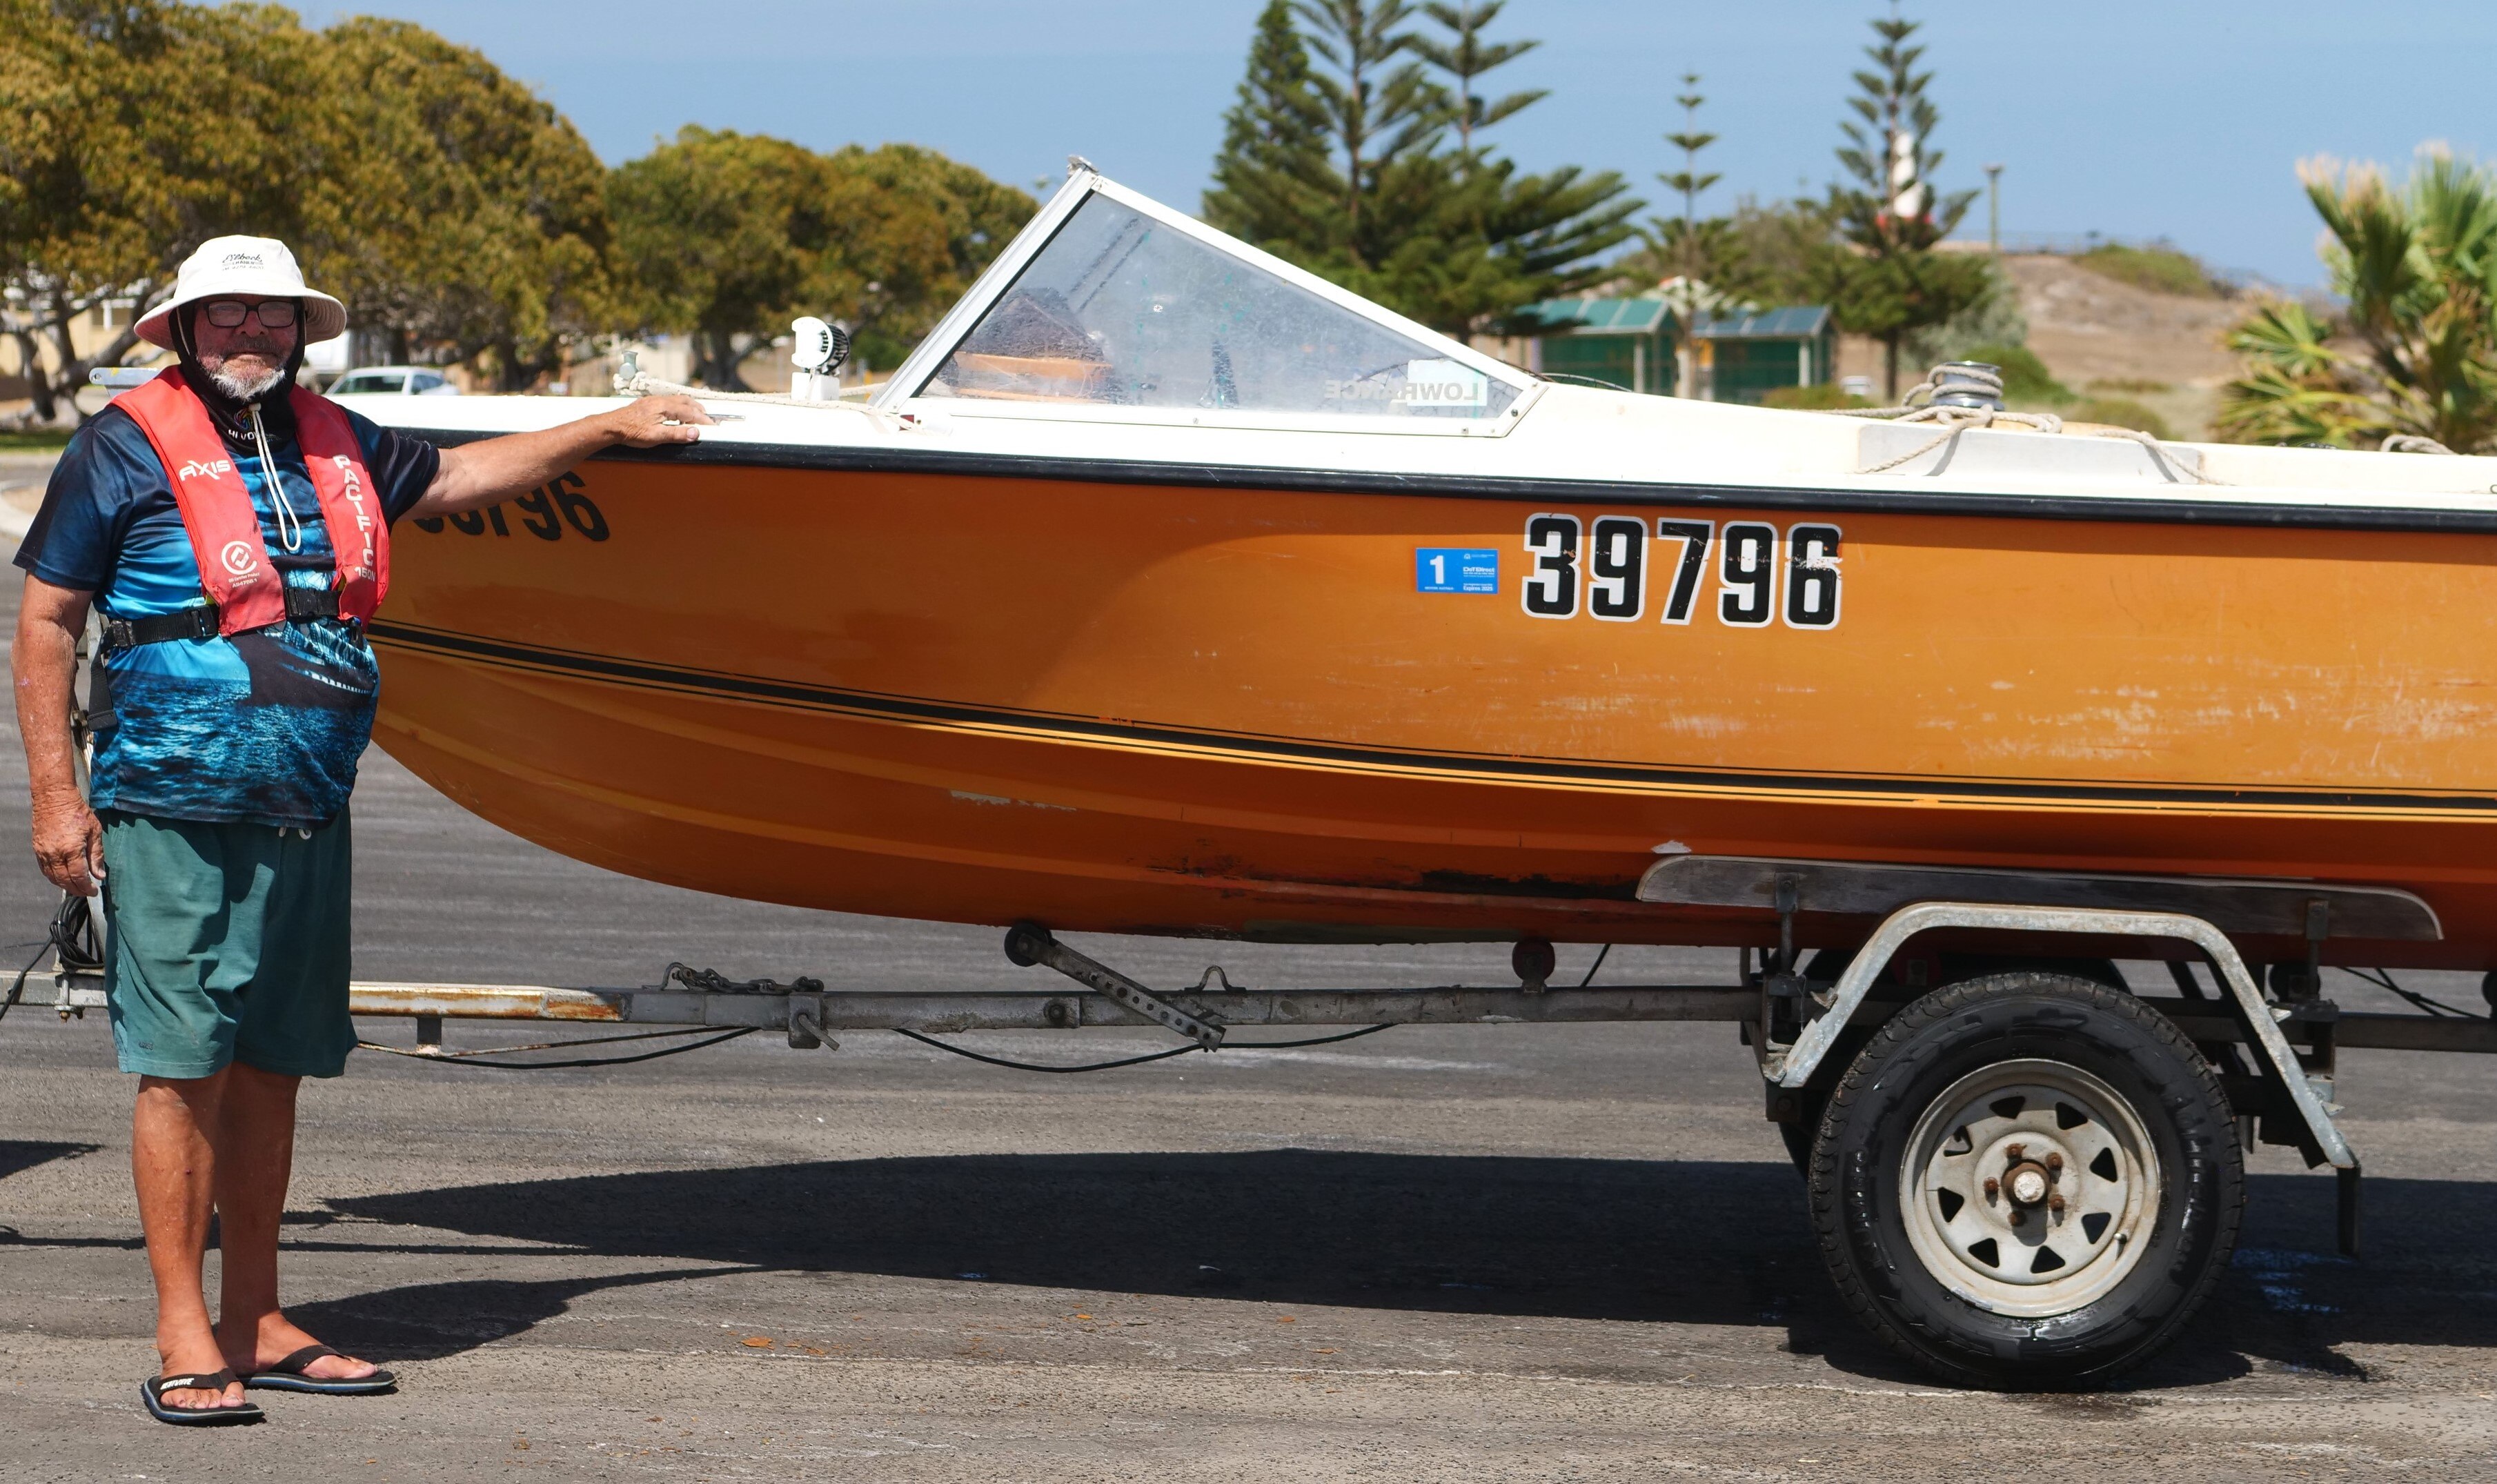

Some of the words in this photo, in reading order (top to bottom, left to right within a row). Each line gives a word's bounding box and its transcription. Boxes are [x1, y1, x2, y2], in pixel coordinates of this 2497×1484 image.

[179, 460, 231, 482] AXIS
[333, 454, 373, 566] PACIFIC
[354, 566, 376, 582] 150N
[1430, 555, 1444, 584] 1
[1521, 512, 1842, 631] 39796
